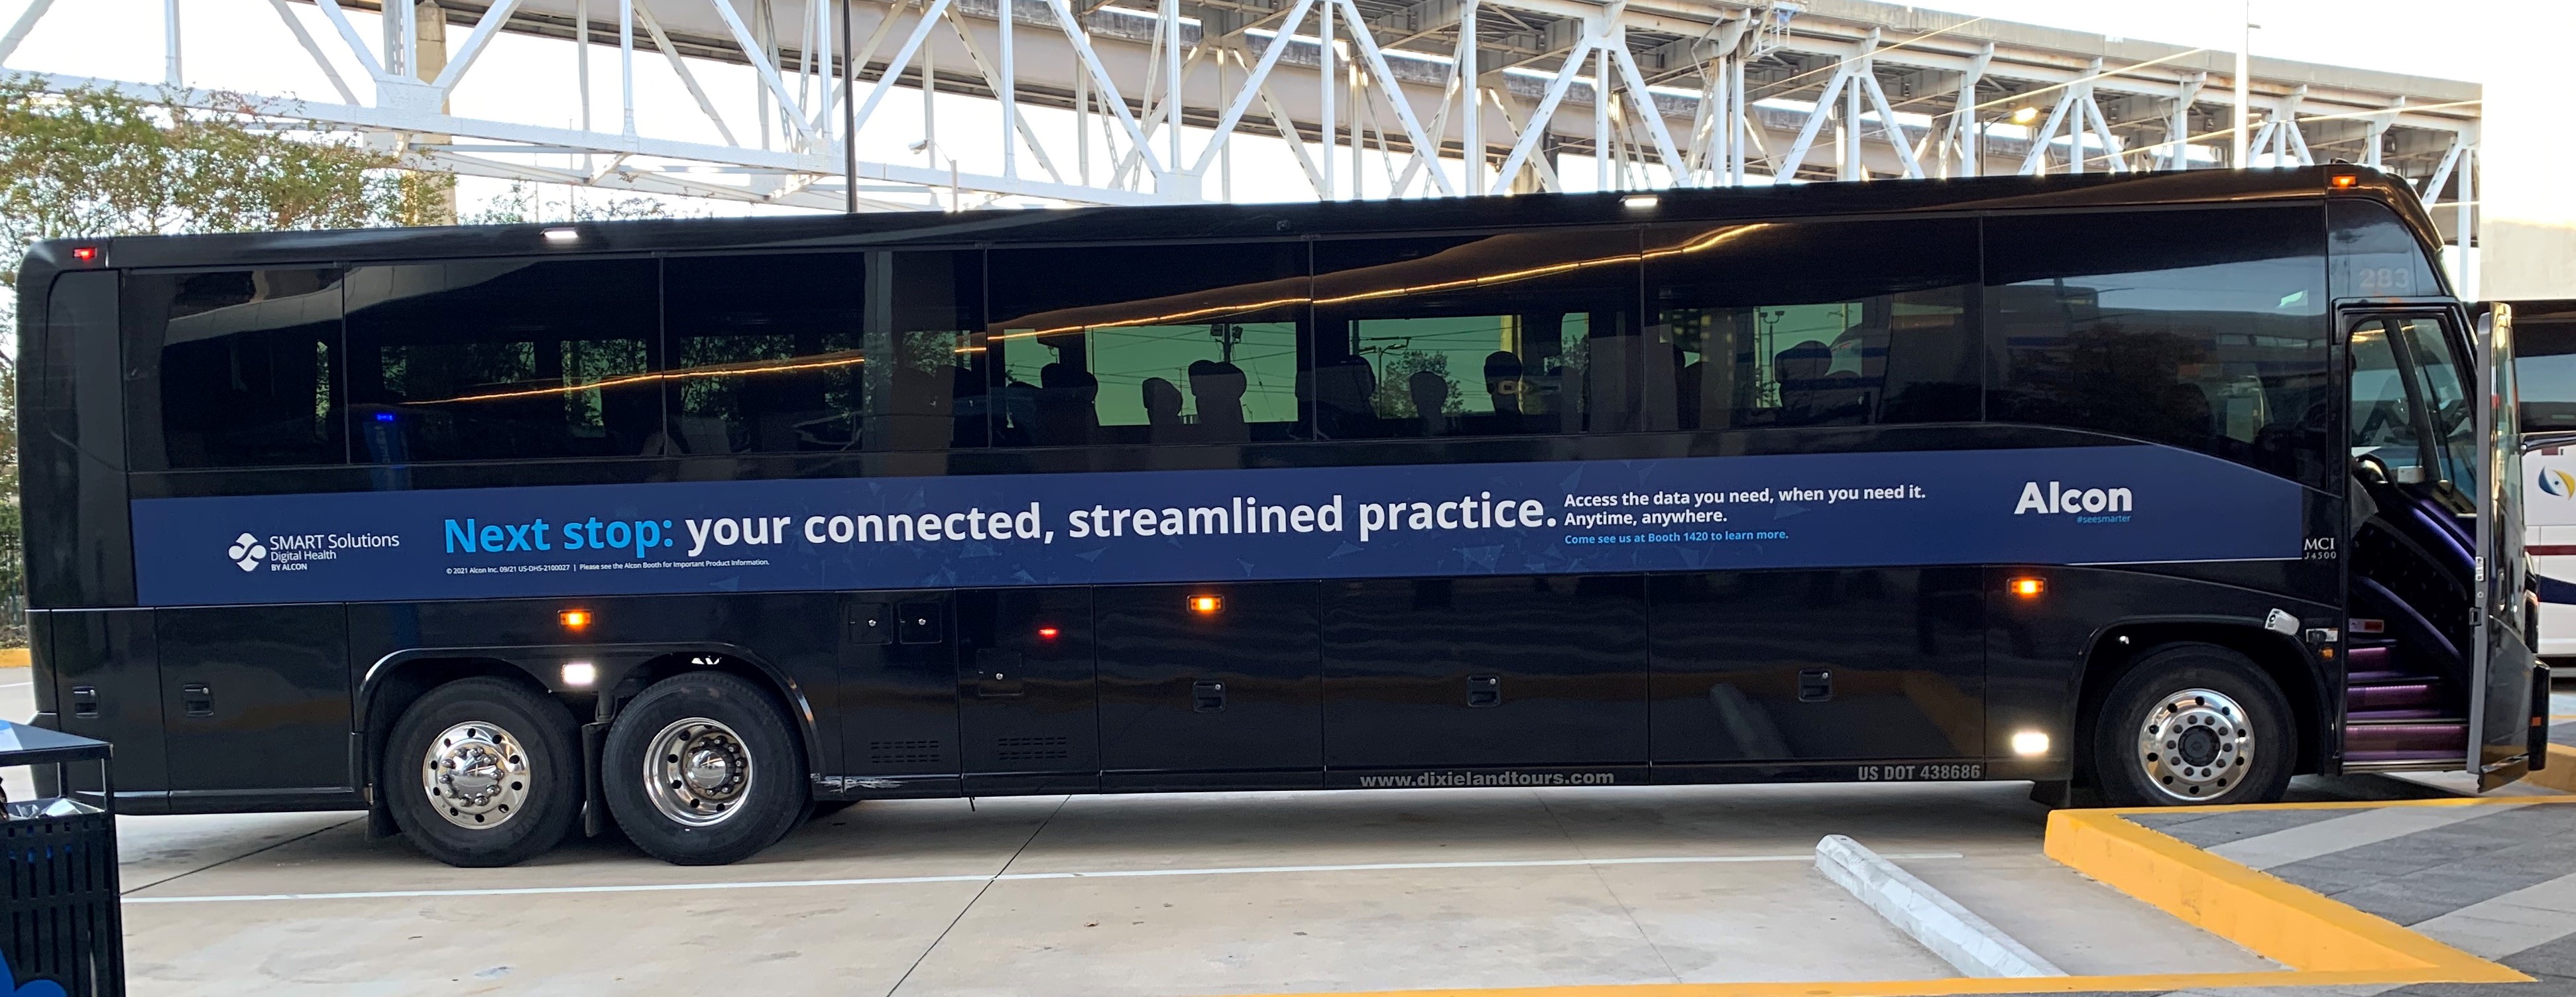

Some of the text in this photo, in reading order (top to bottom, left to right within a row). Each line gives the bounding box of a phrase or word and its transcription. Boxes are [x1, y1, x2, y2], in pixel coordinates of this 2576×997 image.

[2359, 267, 2409, 288] 283
[1564, 484, 1926, 508] Access the data you need, when you need it.
[2013, 481, 2133, 514] Alcon
[445, 491, 1556, 559] Next stop: your connected, streamlined practice.
[1564, 508, 1727, 528] Anytime, anywhere.
[2076, 515, 2131, 524] #seesmarter
[270, 532, 400, 550] SMART Solutions
[1564, 535, 1596, 544] Come
[1633, 534, 1645, 543] at
[1648, 532, 1680, 542] Booth
[1683, 531, 1708, 542] 1420
[1710, 532, 1723, 541] to
[1725, 530, 1754, 540] learn
[1756, 531, 1788, 540] more.
[2304, 537, 2335, 551] MCI
[270, 549, 337, 563] Digital Health
[2304, 551, 2336, 559] J4500
[1360, 772, 1613, 787] www.dixielandtours.com
[1858, 764, 1981, 781] US DOT 438686
